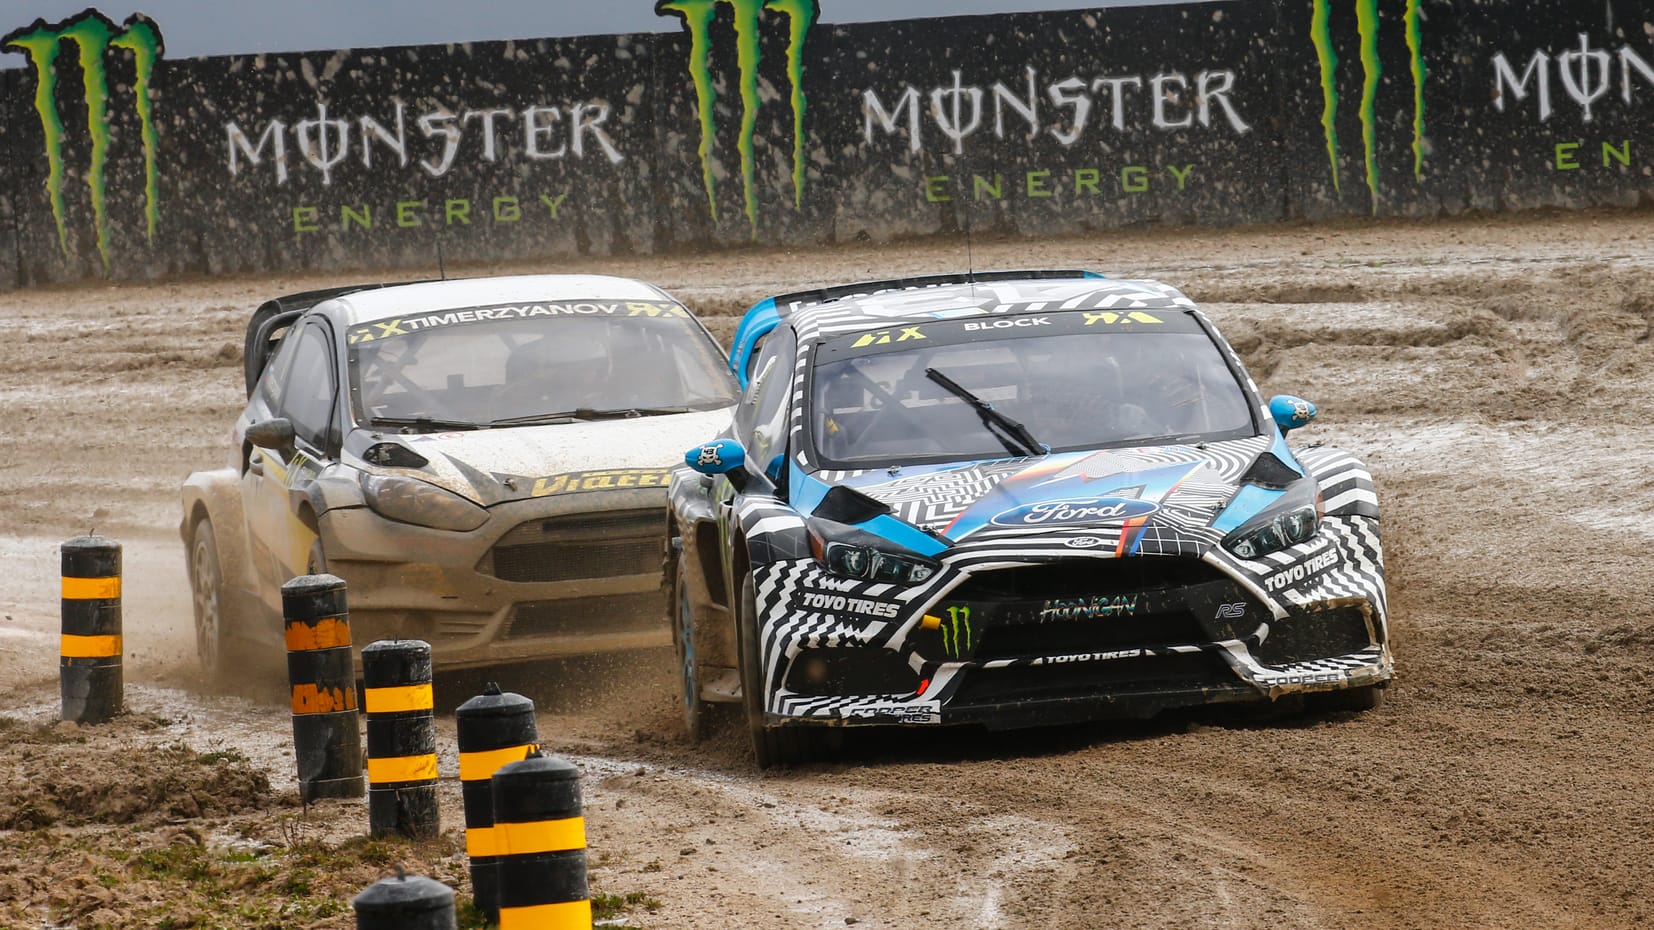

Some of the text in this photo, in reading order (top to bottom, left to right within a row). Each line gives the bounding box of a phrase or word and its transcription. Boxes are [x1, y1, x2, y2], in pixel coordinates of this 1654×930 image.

[864, 67, 1251, 154] MONSTER
[226, 99, 625, 186] MONSTER
[1555, 140, 1631, 170] EN
[925, 164, 1194, 201] ENERGY
[293, 194, 567, 232] ENERGY
[402, 303, 618, 330] TIMERZYANOV
[964, 316, 1052, 331] BLOCK
[1023, 501, 1127, 524] Ford
[1264, 547, 1339, 592] TOYO TIRES
[803, 593, 900, 618] TOYO TIRES
[1215, 602, 1247, 619] RS
[1046, 649, 1141, 664] TOYO TIRES
